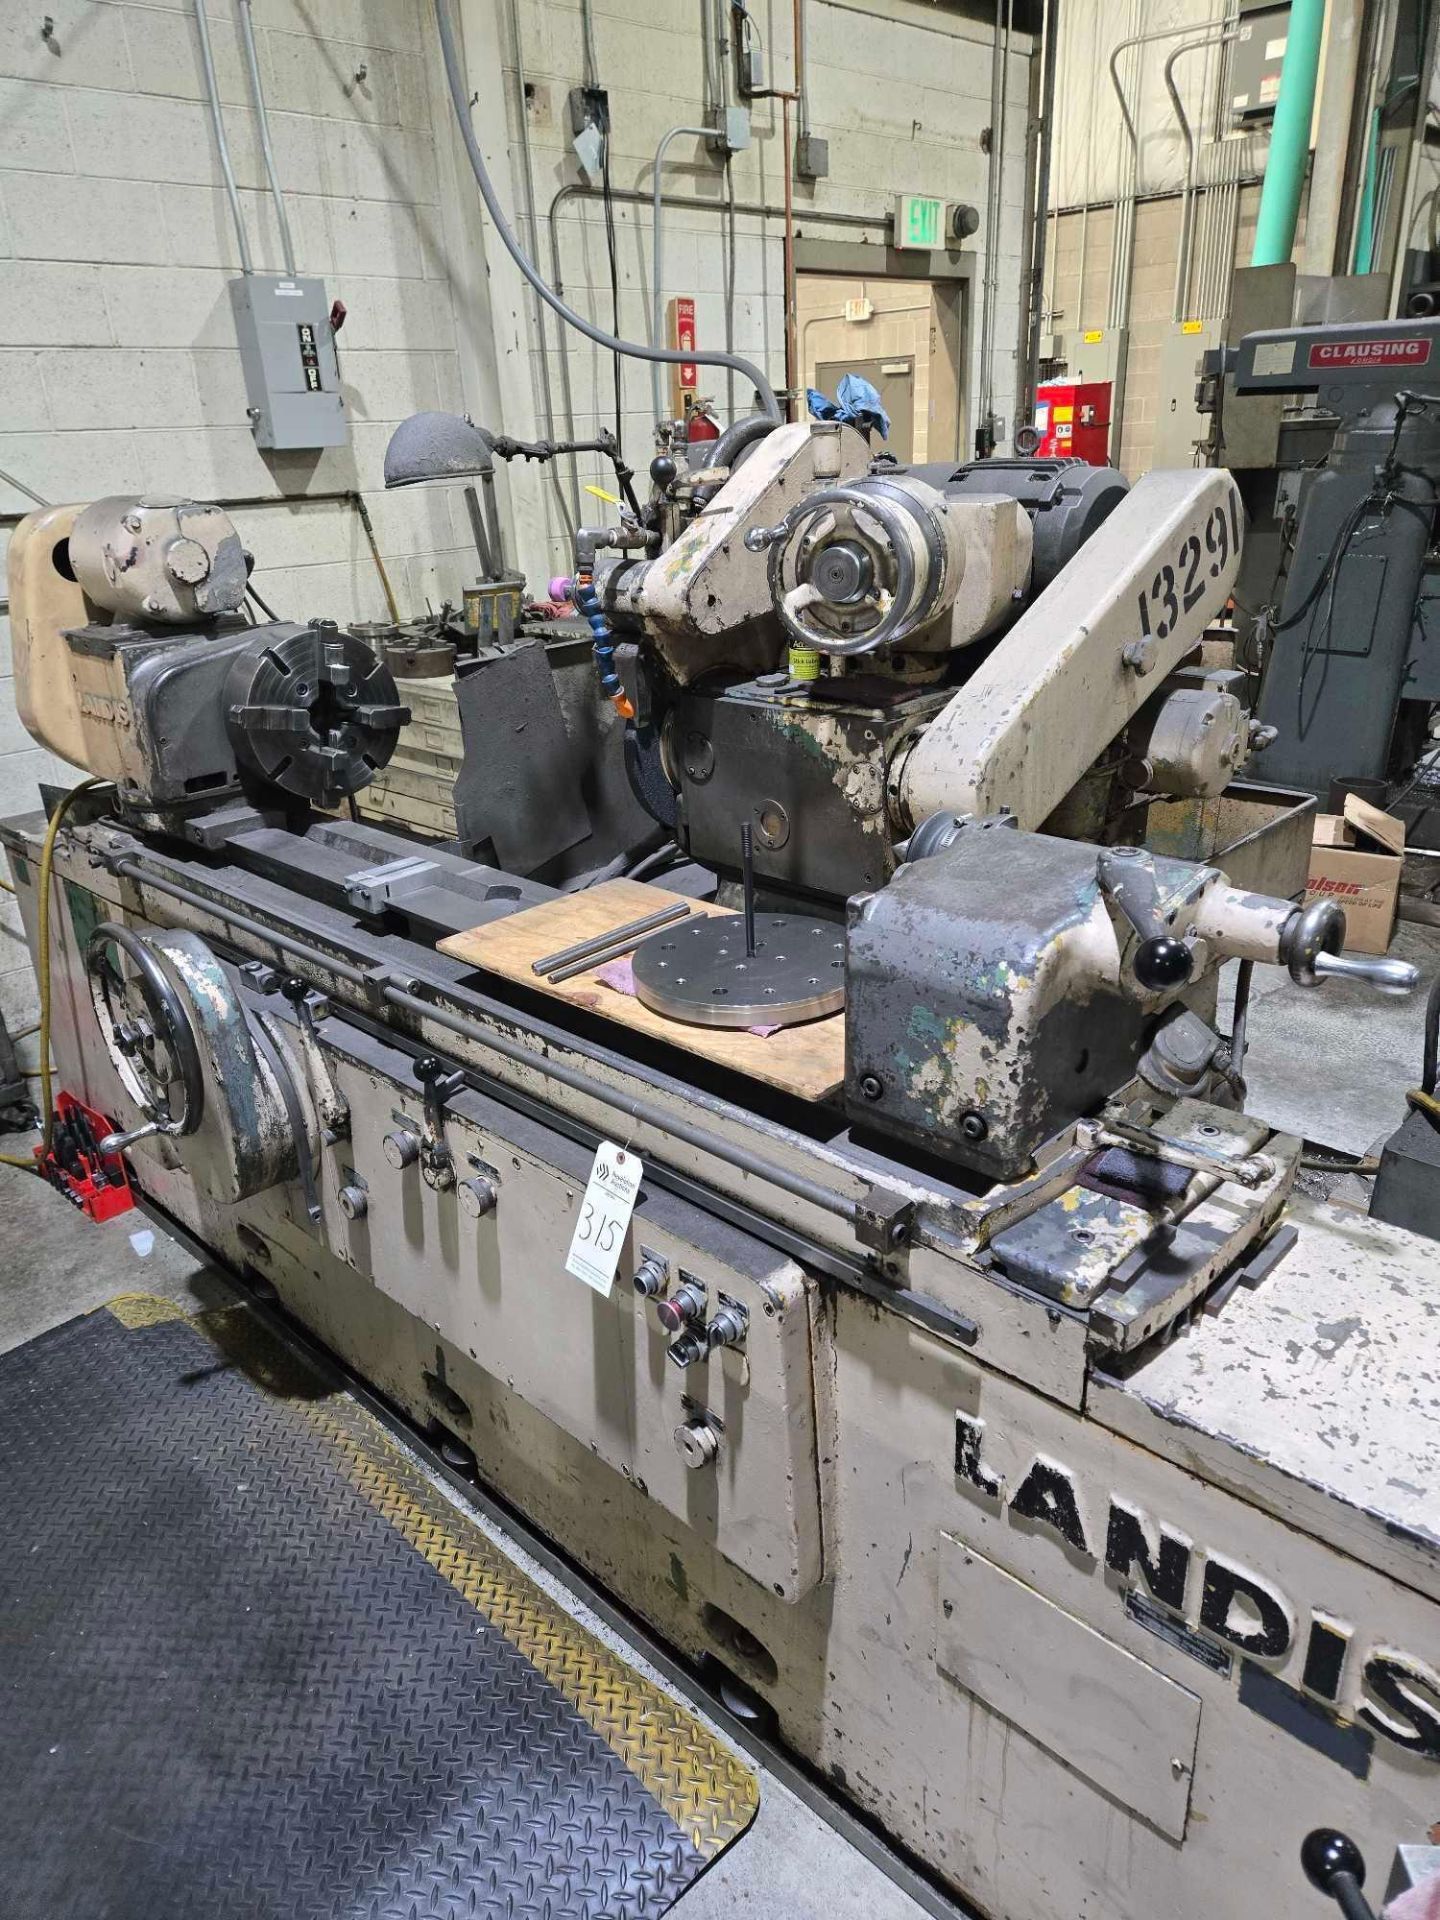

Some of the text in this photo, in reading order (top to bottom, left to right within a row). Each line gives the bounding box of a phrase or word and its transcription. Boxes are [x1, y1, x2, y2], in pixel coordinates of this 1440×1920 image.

[909, 198, 941, 244] EXIT
[679, 304, 694, 315] FIRE
[301, 328, 312, 342] ON
[1319, 342, 1420, 358] CLAUSING
[1138, 487, 1240, 639] 13291
[578, 1201, 624, 1252] 315
[953, 1411, 1440, 1758] LANDIS
